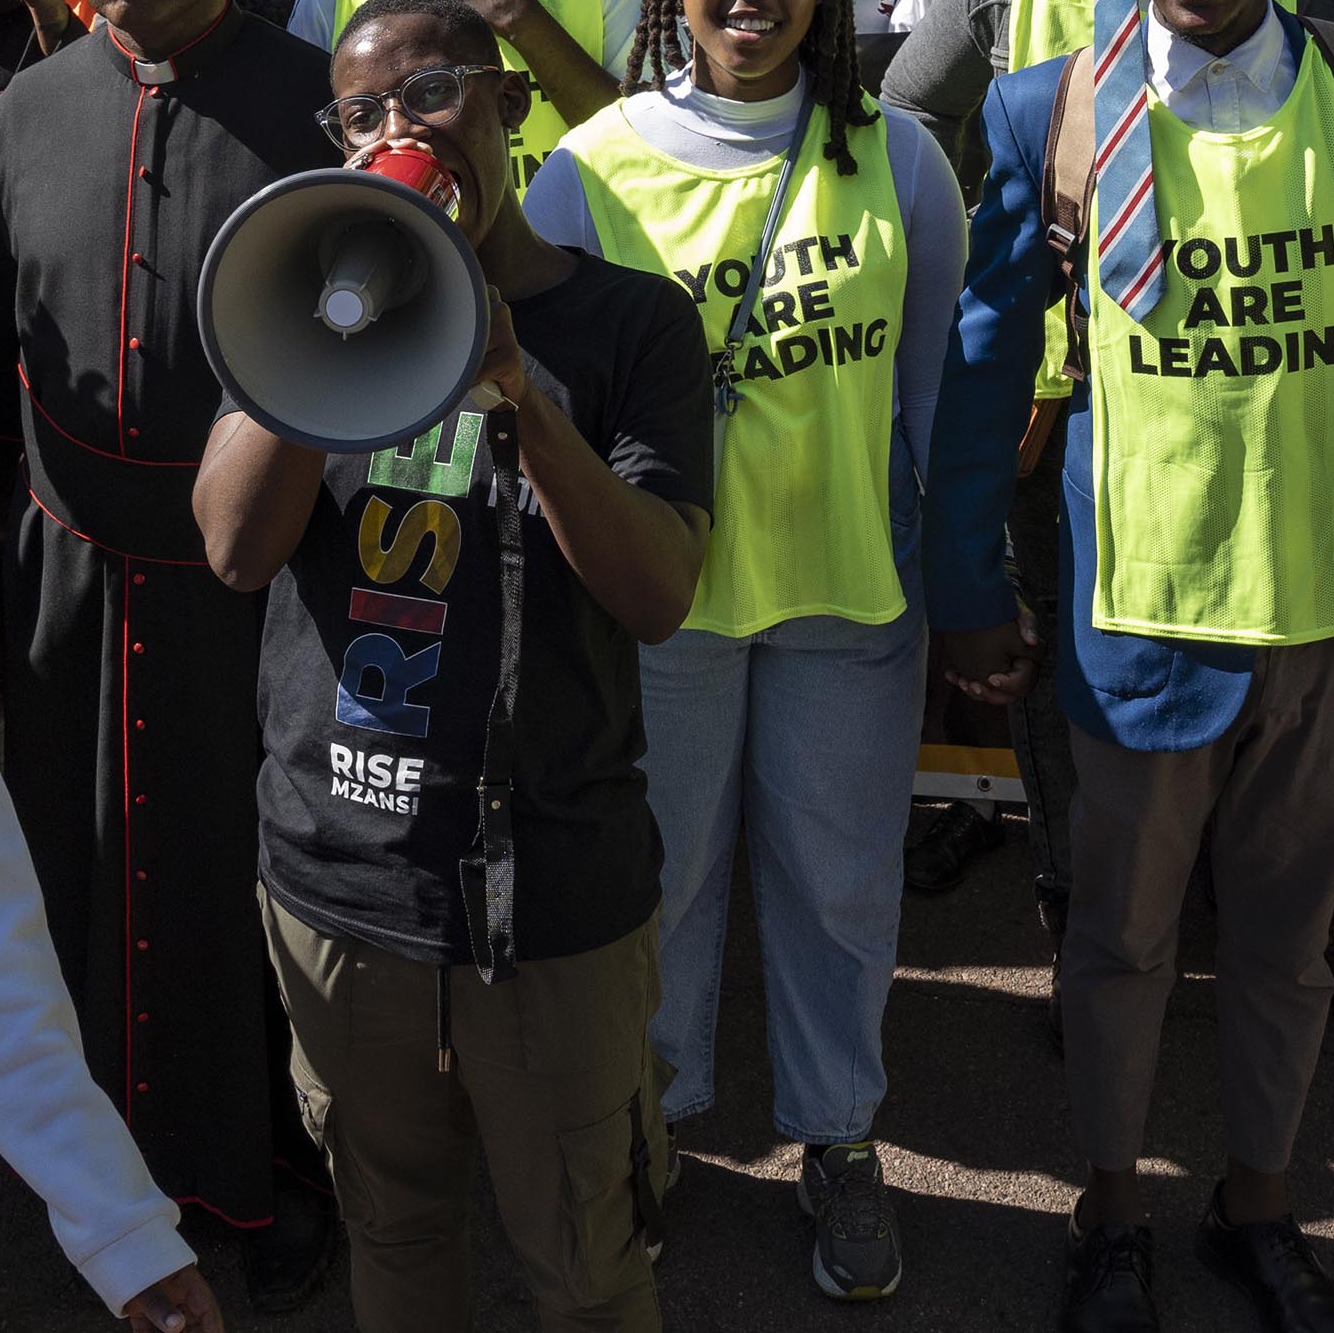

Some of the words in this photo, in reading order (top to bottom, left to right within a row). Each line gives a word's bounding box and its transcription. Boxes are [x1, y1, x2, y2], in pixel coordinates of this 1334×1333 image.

[673, 233, 860, 304] YOUTH
[730, 280, 836, 339] ARE
[1184, 280, 1306, 330] ARE
[711, 318, 889, 388] EADING
[335, 411, 484, 738] RISE
[329, 741, 425, 793] RISE
[330, 776, 420, 817] MZANSI
